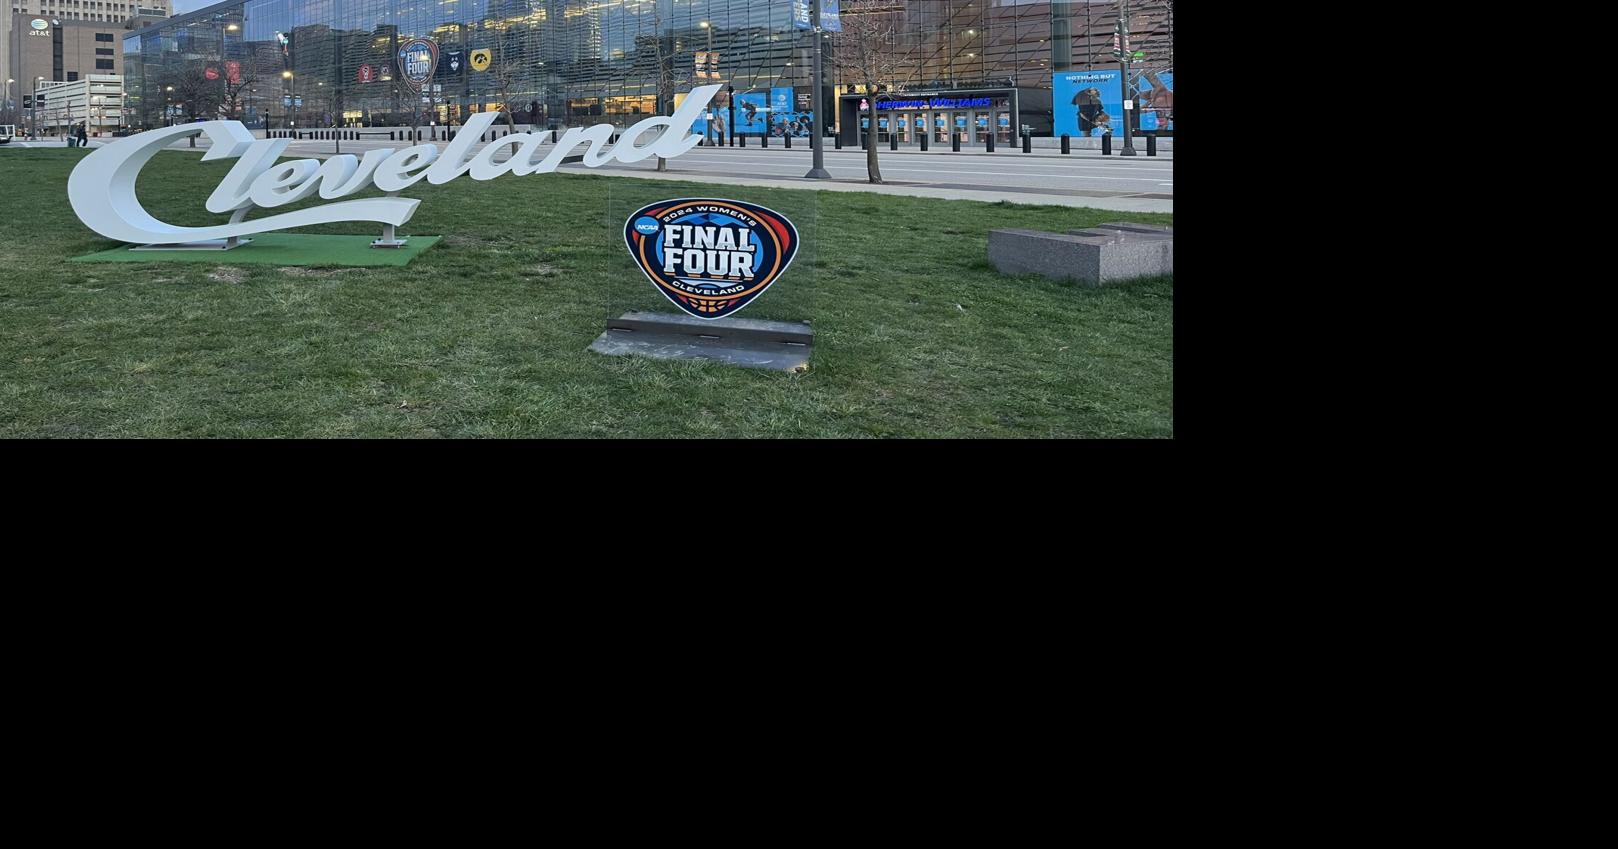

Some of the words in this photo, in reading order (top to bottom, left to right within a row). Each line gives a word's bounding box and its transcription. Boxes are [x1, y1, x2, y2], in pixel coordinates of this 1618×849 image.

[407, 51, 432, 63] FINAL
[407, 61, 429, 74] FOUR
[874, 97, 991, 109] HERWIN-WILLIAMS
[68, 84, 722, 244] Cleveland
[663, 206, 693, 223] 2024
[697, 205, 757, 227] WOMEN'S
[664, 224, 755, 251] FINAL
[663, 248, 754, 278] FOUR
[671, 280, 746, 296] CLEVELAND
